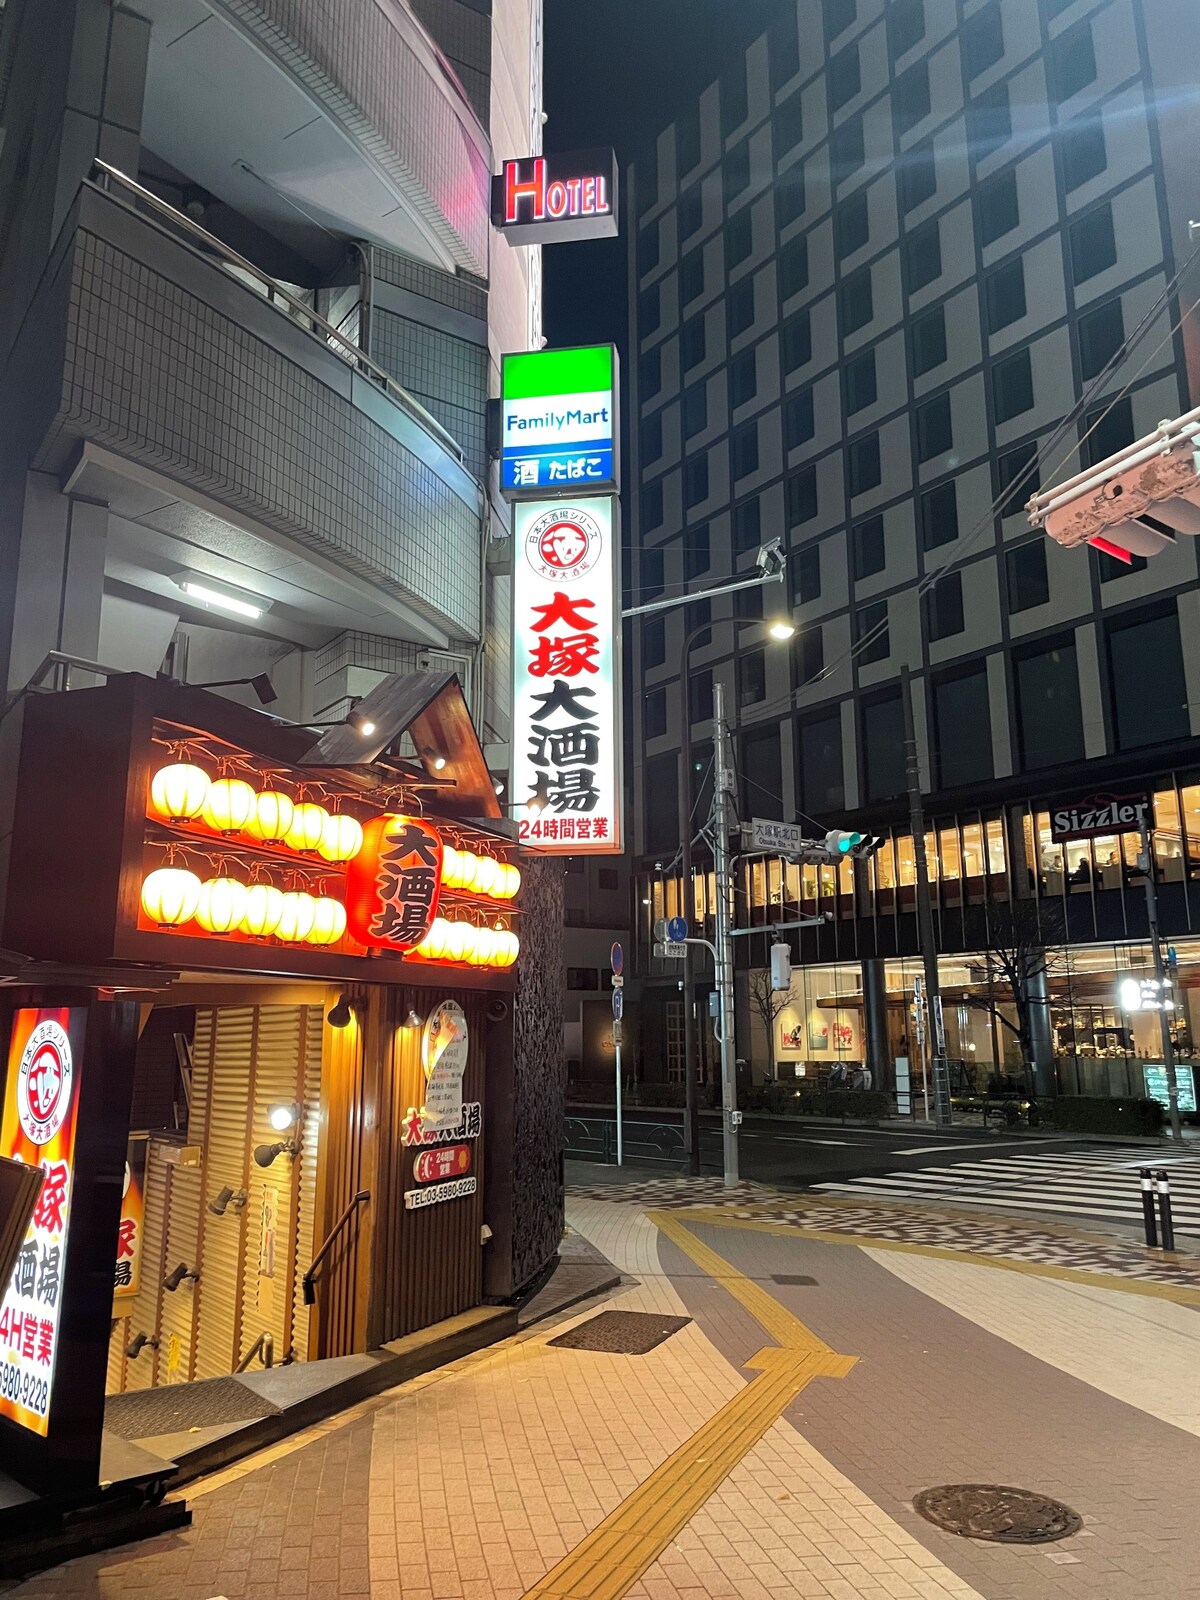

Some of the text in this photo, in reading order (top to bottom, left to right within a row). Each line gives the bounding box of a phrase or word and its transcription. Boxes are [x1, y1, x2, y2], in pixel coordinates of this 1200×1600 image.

[507, 406, 609, 432] FamilyMart
[513, 457, 603, 486] 酒 たばこ
[528, 510, 599, 544] 日本大酒場シリーズ
[518, 816, 609, 841] 24時間営業
[755, 823, 799, 841] 大塚駅北口
[1053, 801, 1149, 835] Sizzler
[368, 824, 438, 945] 大酒場
[33, 1161, 69, 1234] 塚
